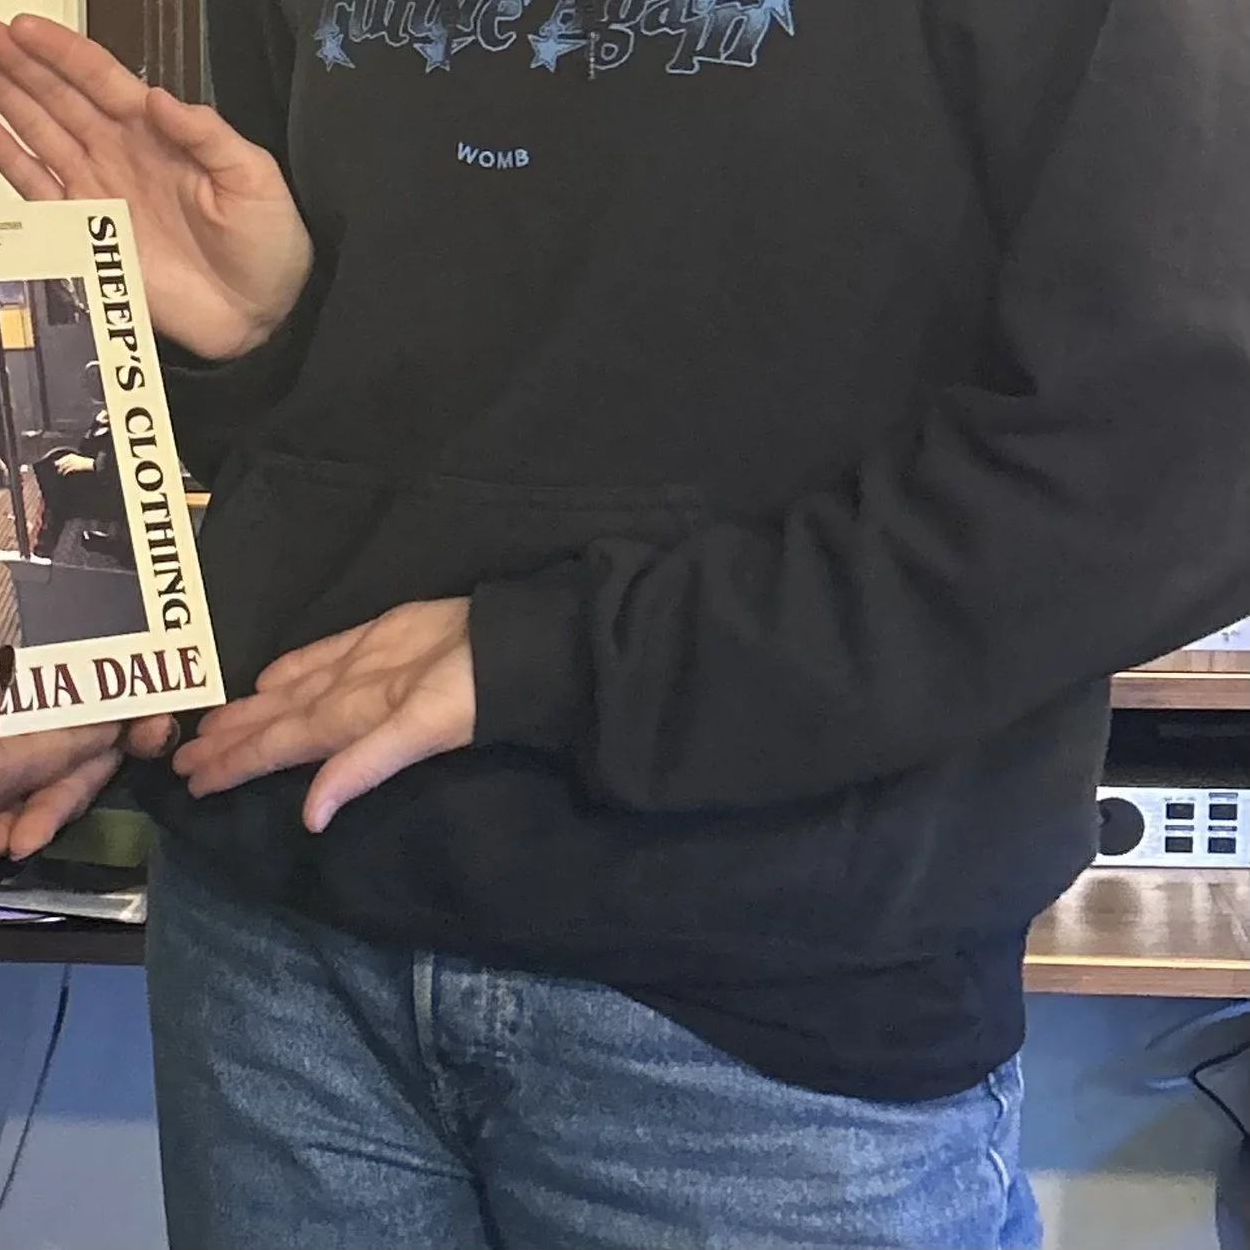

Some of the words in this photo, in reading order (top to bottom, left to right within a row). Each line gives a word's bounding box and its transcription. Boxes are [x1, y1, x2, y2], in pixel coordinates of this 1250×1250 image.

[456, 141, 530, 170] WOMB
[87, 215, 146, 392] SHEEP'S
[124, 406, 192, 632] CLOTHING
[0, 661, 85, 715] LIA
[92, 644, 208, 702] DALE
